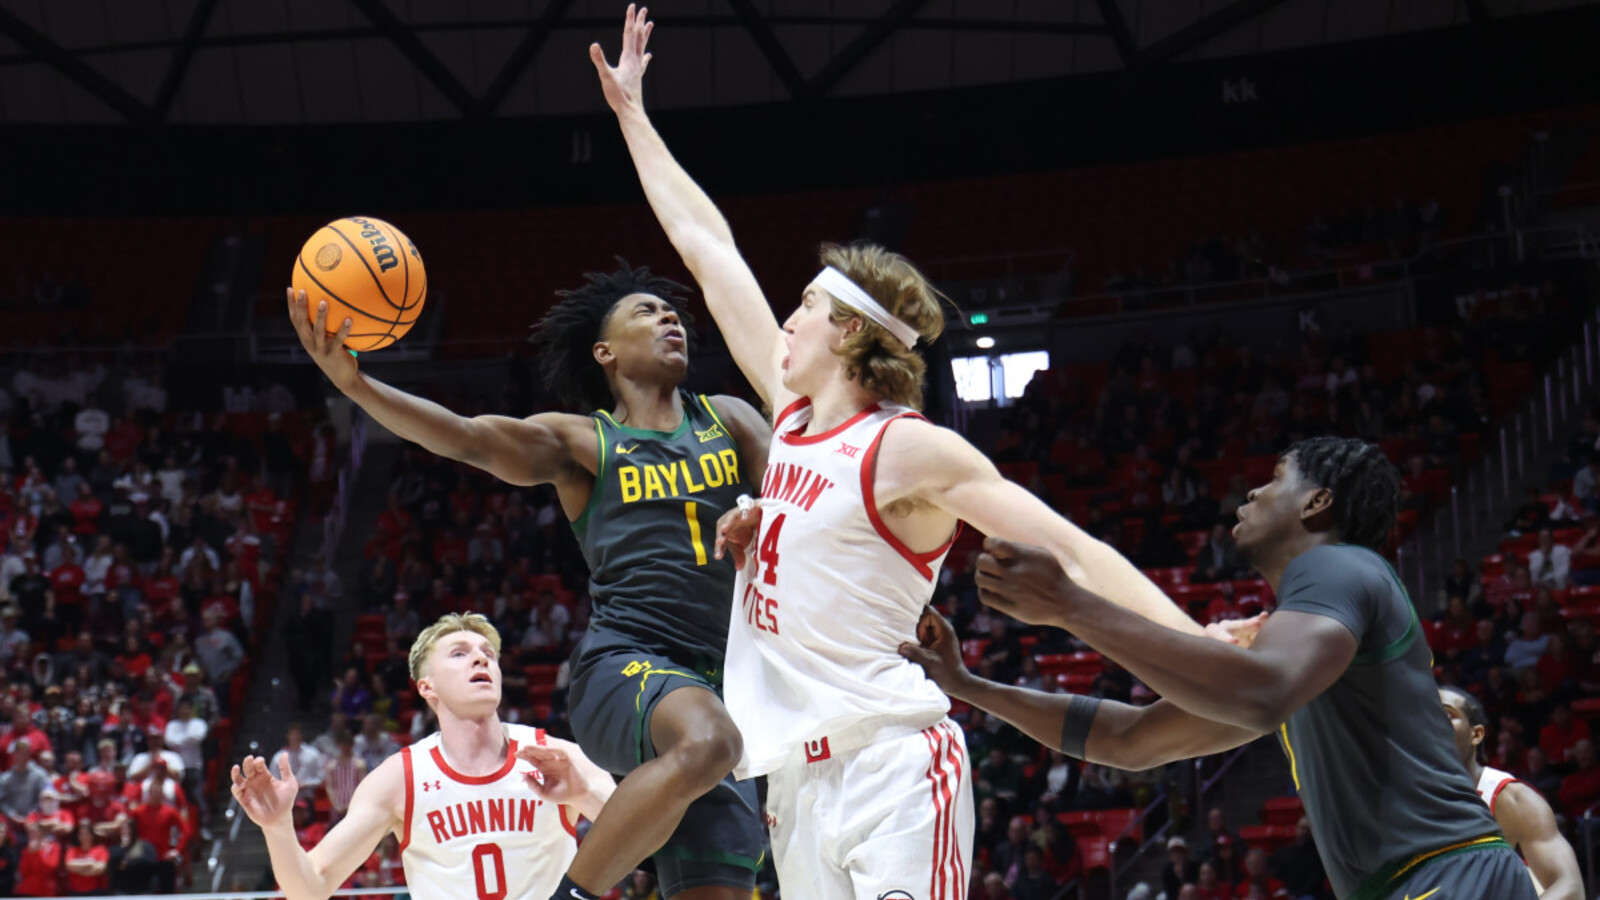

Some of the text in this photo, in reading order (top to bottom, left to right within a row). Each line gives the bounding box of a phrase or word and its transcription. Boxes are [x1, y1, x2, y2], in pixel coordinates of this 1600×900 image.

[348, 217, 399, 273] Wilso
[1299, 311, 1320, 331] K
[618, 448, 740, 504] BAYLOR
[685, 501, 708, 566] 1
[754, 508, 786, 586] 4
[427, 798, 543, 844] RUNNIN'
[472, 842, 507, 900] 0
